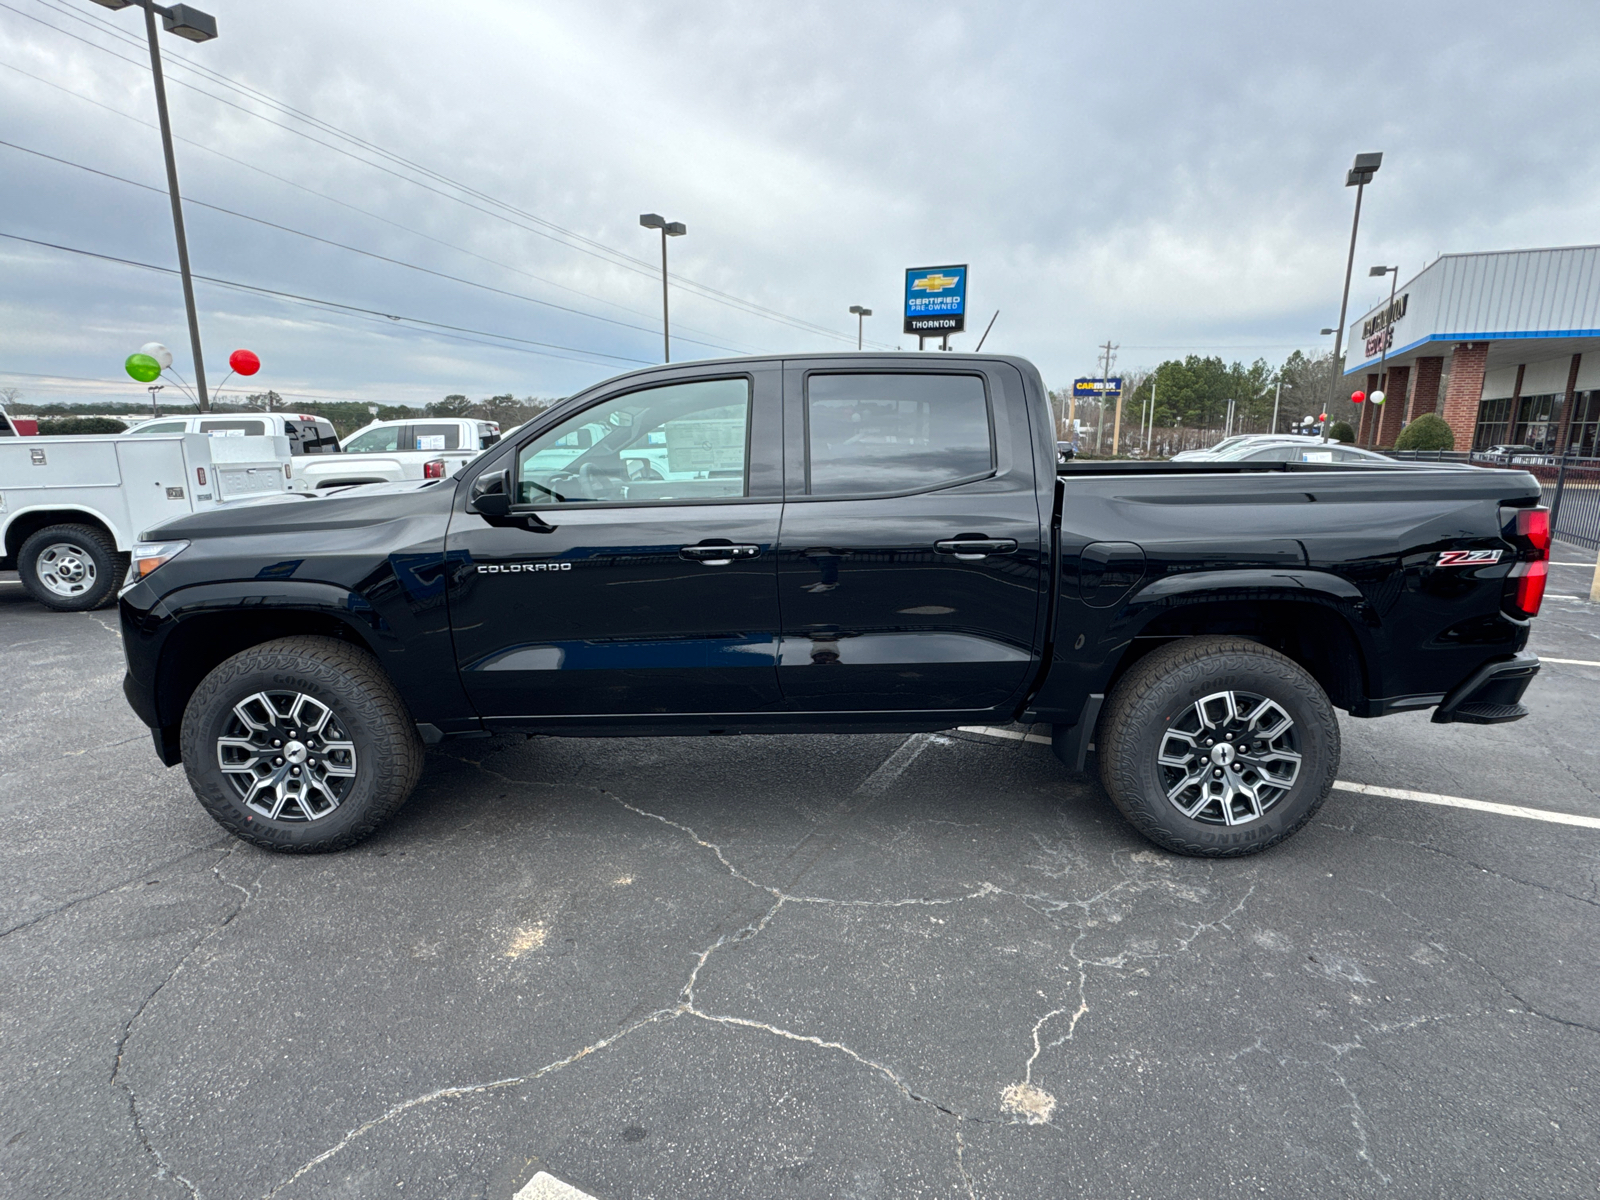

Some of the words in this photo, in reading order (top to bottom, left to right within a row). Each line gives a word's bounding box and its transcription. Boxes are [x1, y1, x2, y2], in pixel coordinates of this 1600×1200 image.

[909, 296, 960, 305] CERTIFIED
[911, 303, 957, 311] PRE-OWNED
[912, 319, 955, 328] THORNTON
[1435, 549, 1503, 567] Z71
[477, 562, 572, 574] COLORADO
